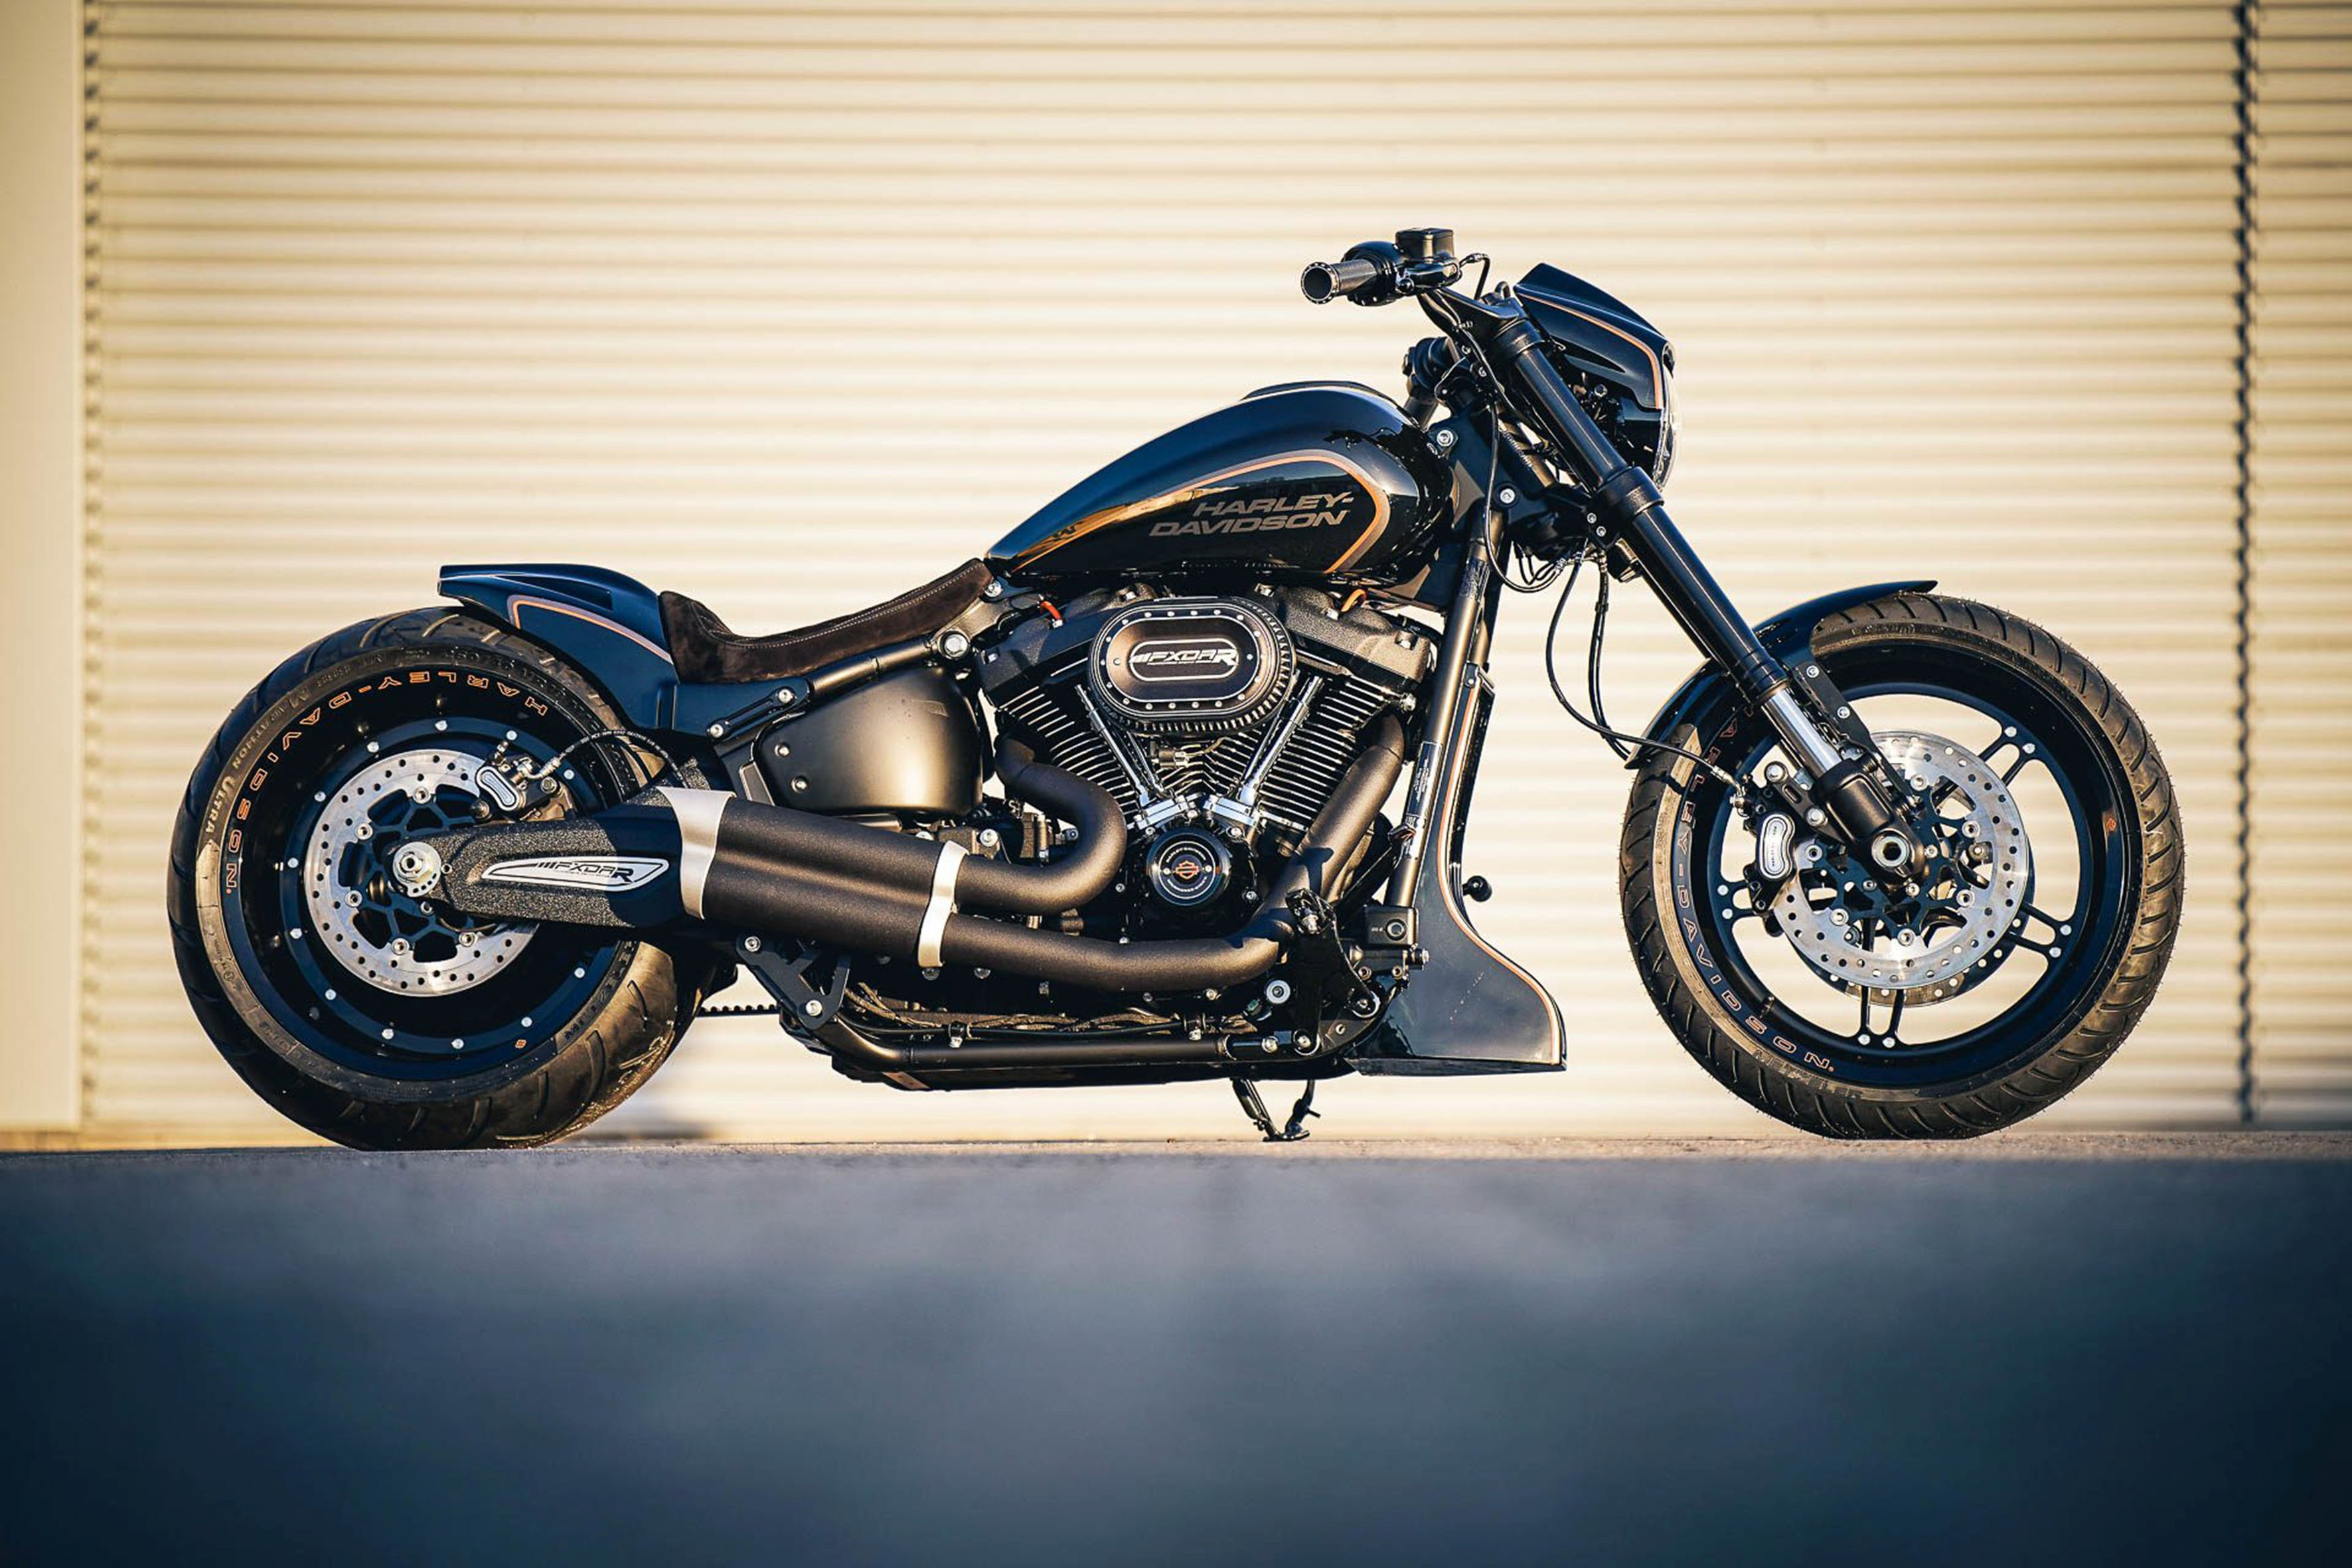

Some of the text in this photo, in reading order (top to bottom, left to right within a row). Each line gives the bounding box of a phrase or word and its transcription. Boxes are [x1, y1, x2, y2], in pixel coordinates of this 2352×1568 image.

[1193, 491, 1355, 516] HARLEY-
[1148, 509, 1350, 536] DAVIDSON
[204, 775, 236, 833] ULTRA
